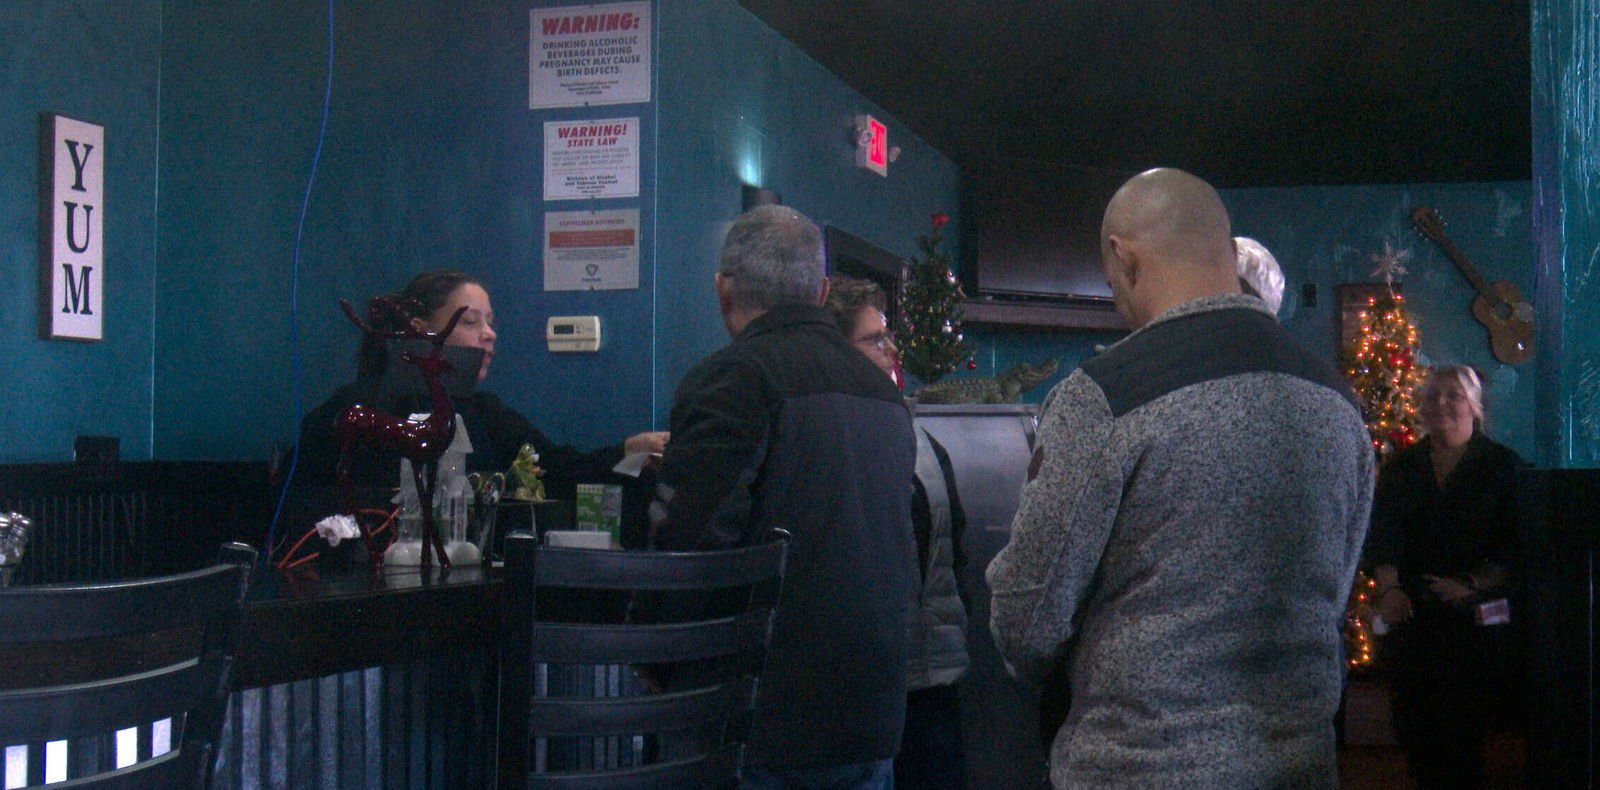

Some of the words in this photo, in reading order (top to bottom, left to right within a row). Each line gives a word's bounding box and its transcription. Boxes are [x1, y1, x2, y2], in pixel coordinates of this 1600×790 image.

[542, 12, 640, 36] WARNING:
[542, 39, 587, 50] DRINKING
[589, 36, 638, 47] ALCOHOLIC
[547, 48, 597, 59] BEVERAGES
[598, 46, 632, 55] DURING
[540, 58, 590, 69] PREGNANCY
[592, 57, 612, 66] MAY
[613, 55, 640, 64] CAUSE
[557, 67, 582, 77] BIRTH
[558, 123, 627, 139] WARNING!
[567, 138, 595, 148] STATE
[597, 137, 618, 146] LAW
[62, 139, 94, 315] YUM
